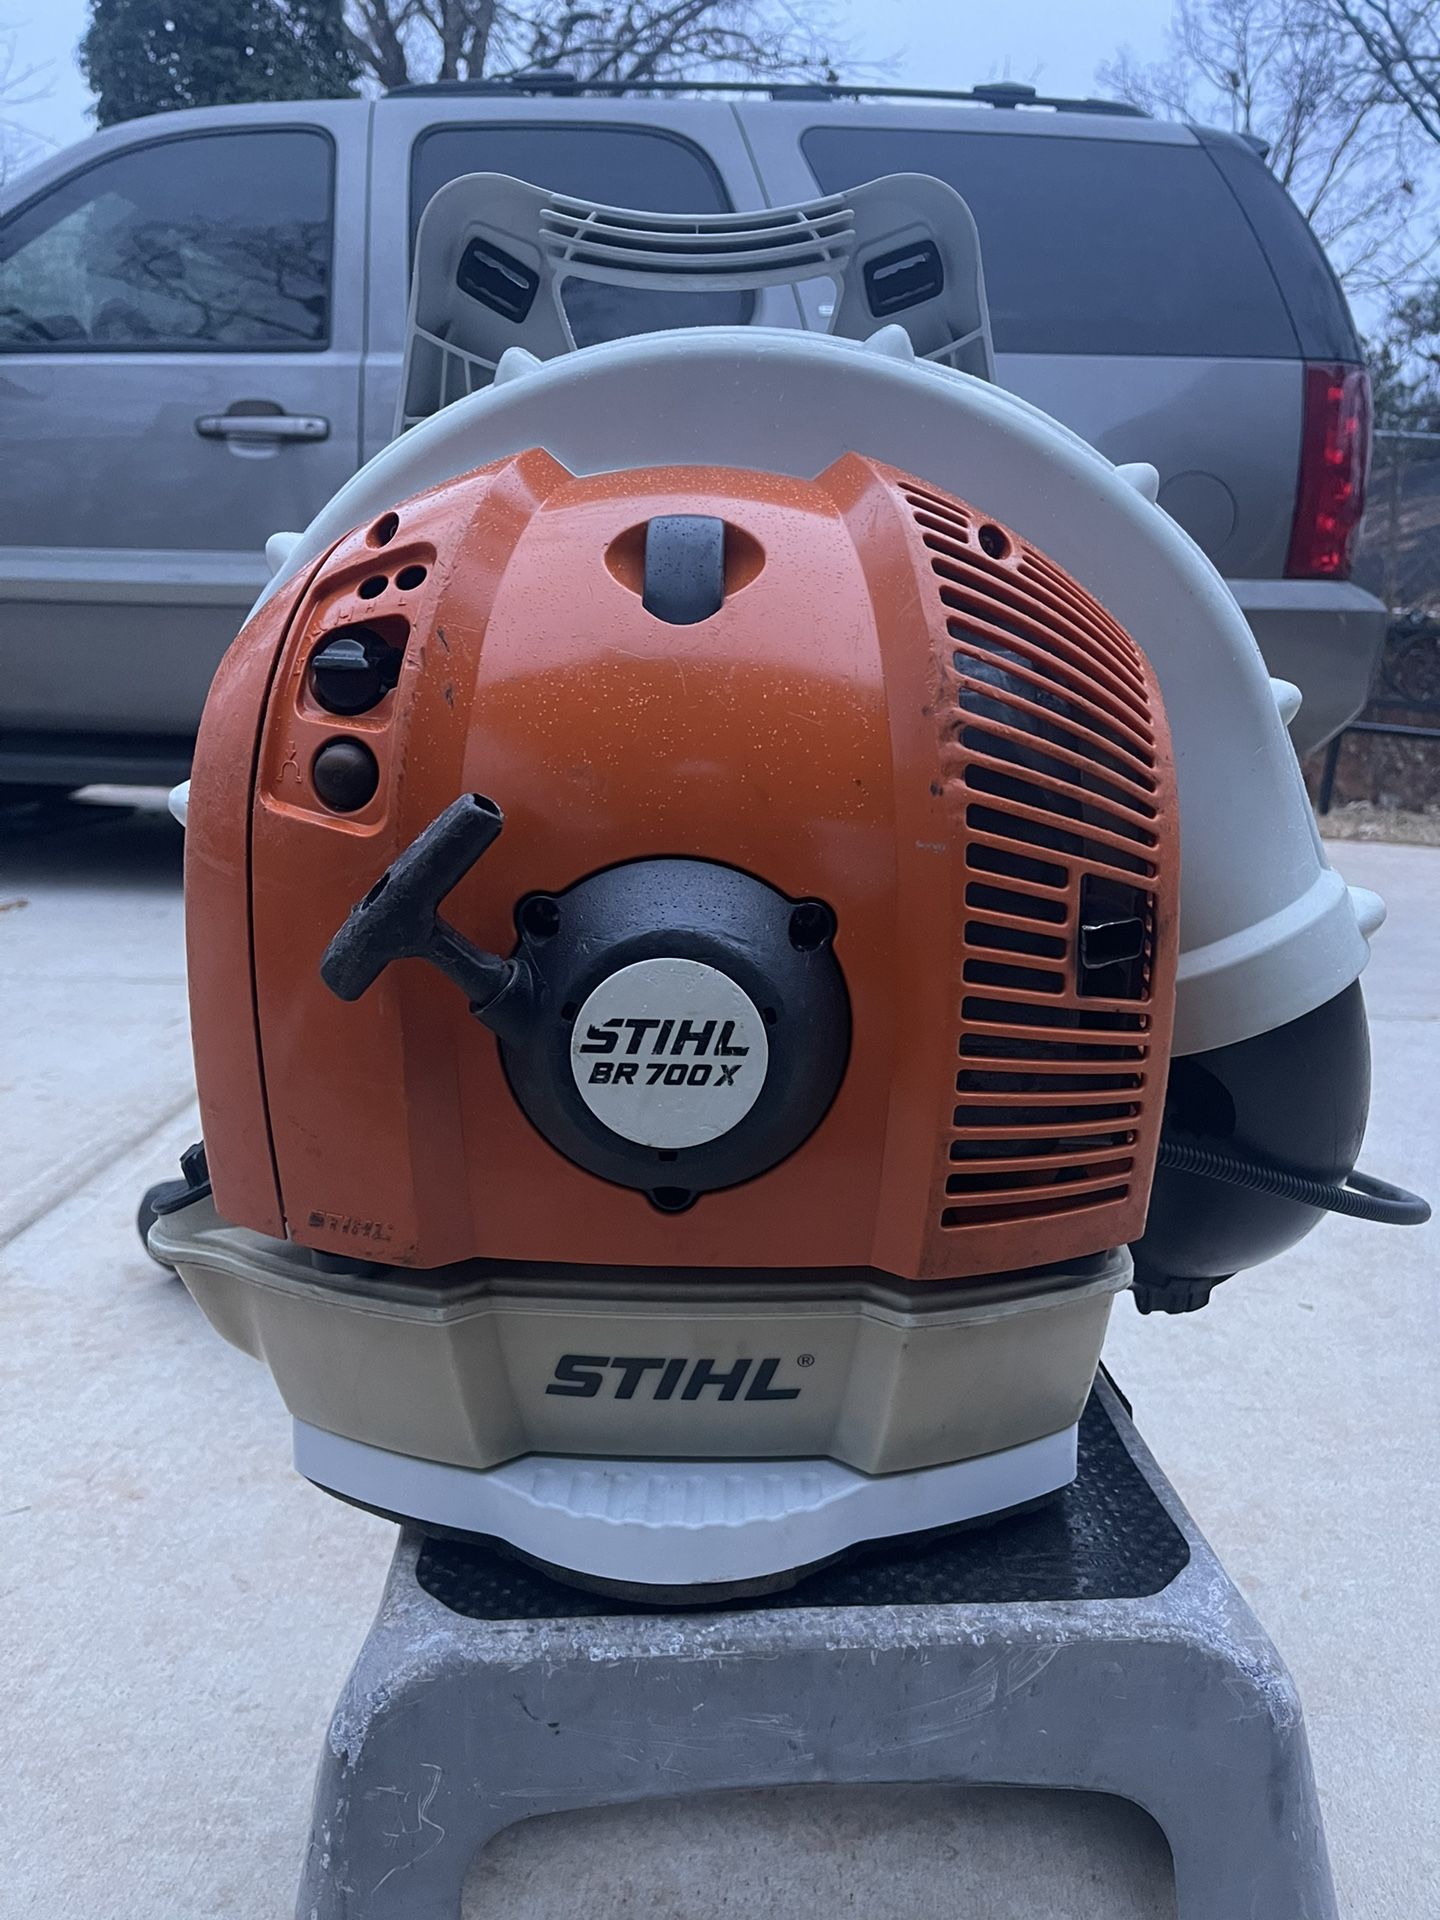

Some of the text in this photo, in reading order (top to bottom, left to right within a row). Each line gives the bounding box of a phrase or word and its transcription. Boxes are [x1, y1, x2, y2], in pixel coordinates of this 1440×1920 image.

[579, 1018, 750, 1056] STIHL
[588, 1062, 639, 1085] BR
[545, 1354, 801, 1401] STIHL
